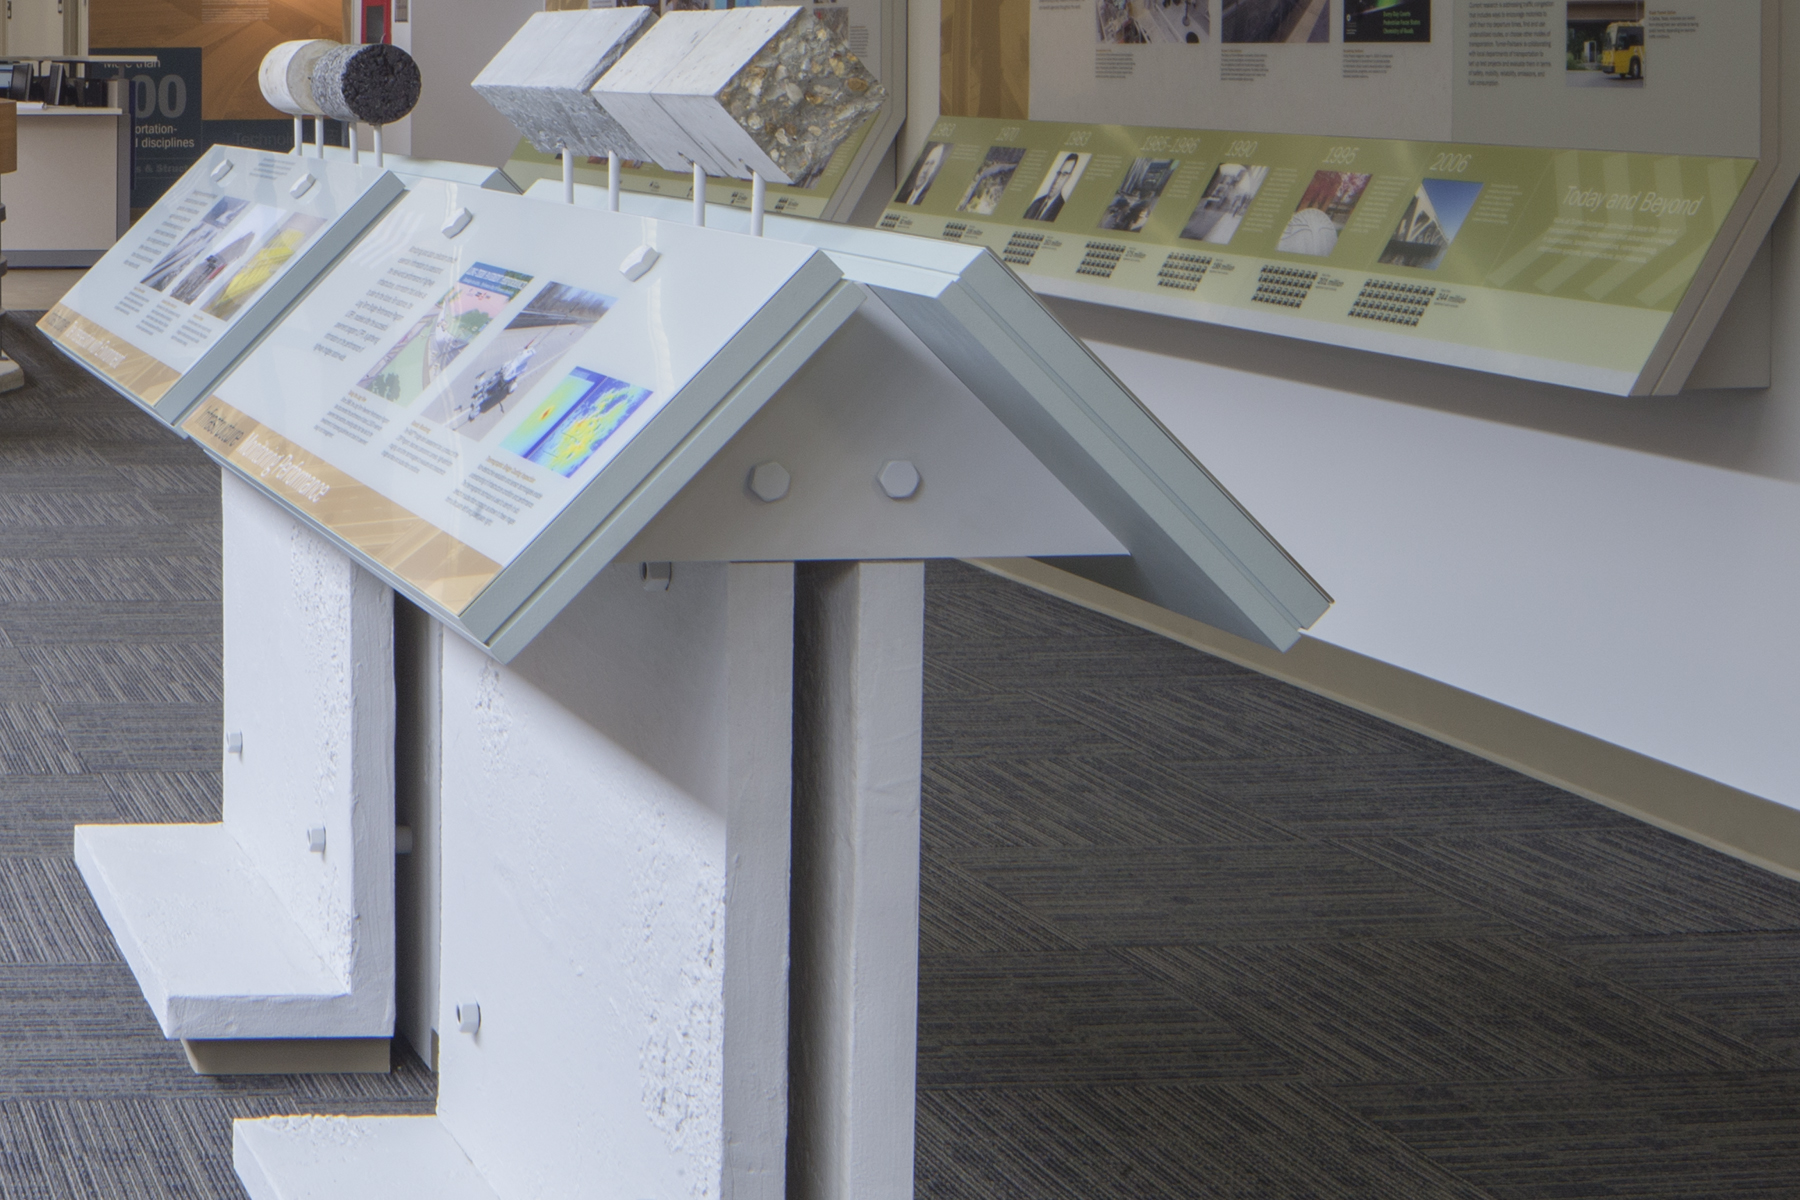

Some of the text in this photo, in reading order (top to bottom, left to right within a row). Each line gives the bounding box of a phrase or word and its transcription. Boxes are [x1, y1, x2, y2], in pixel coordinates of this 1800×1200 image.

[141, 136, 195, 149] disciplines
[995, 127, 1020, 142] 1970
[1064, 131, 1093, 147] 1983
[1225, 140, 1258, 158] 1990
[1322, 146, 1361, 165] 1995
[1429, 152, 1473, 173] 2006
[1563, 185, 1705, 218] Today and Beyond
[194, 404, 245, 447] Infrastructure
[235, 431, 285, 478] Monitoring
[271, 453, 331, 503] Performance
